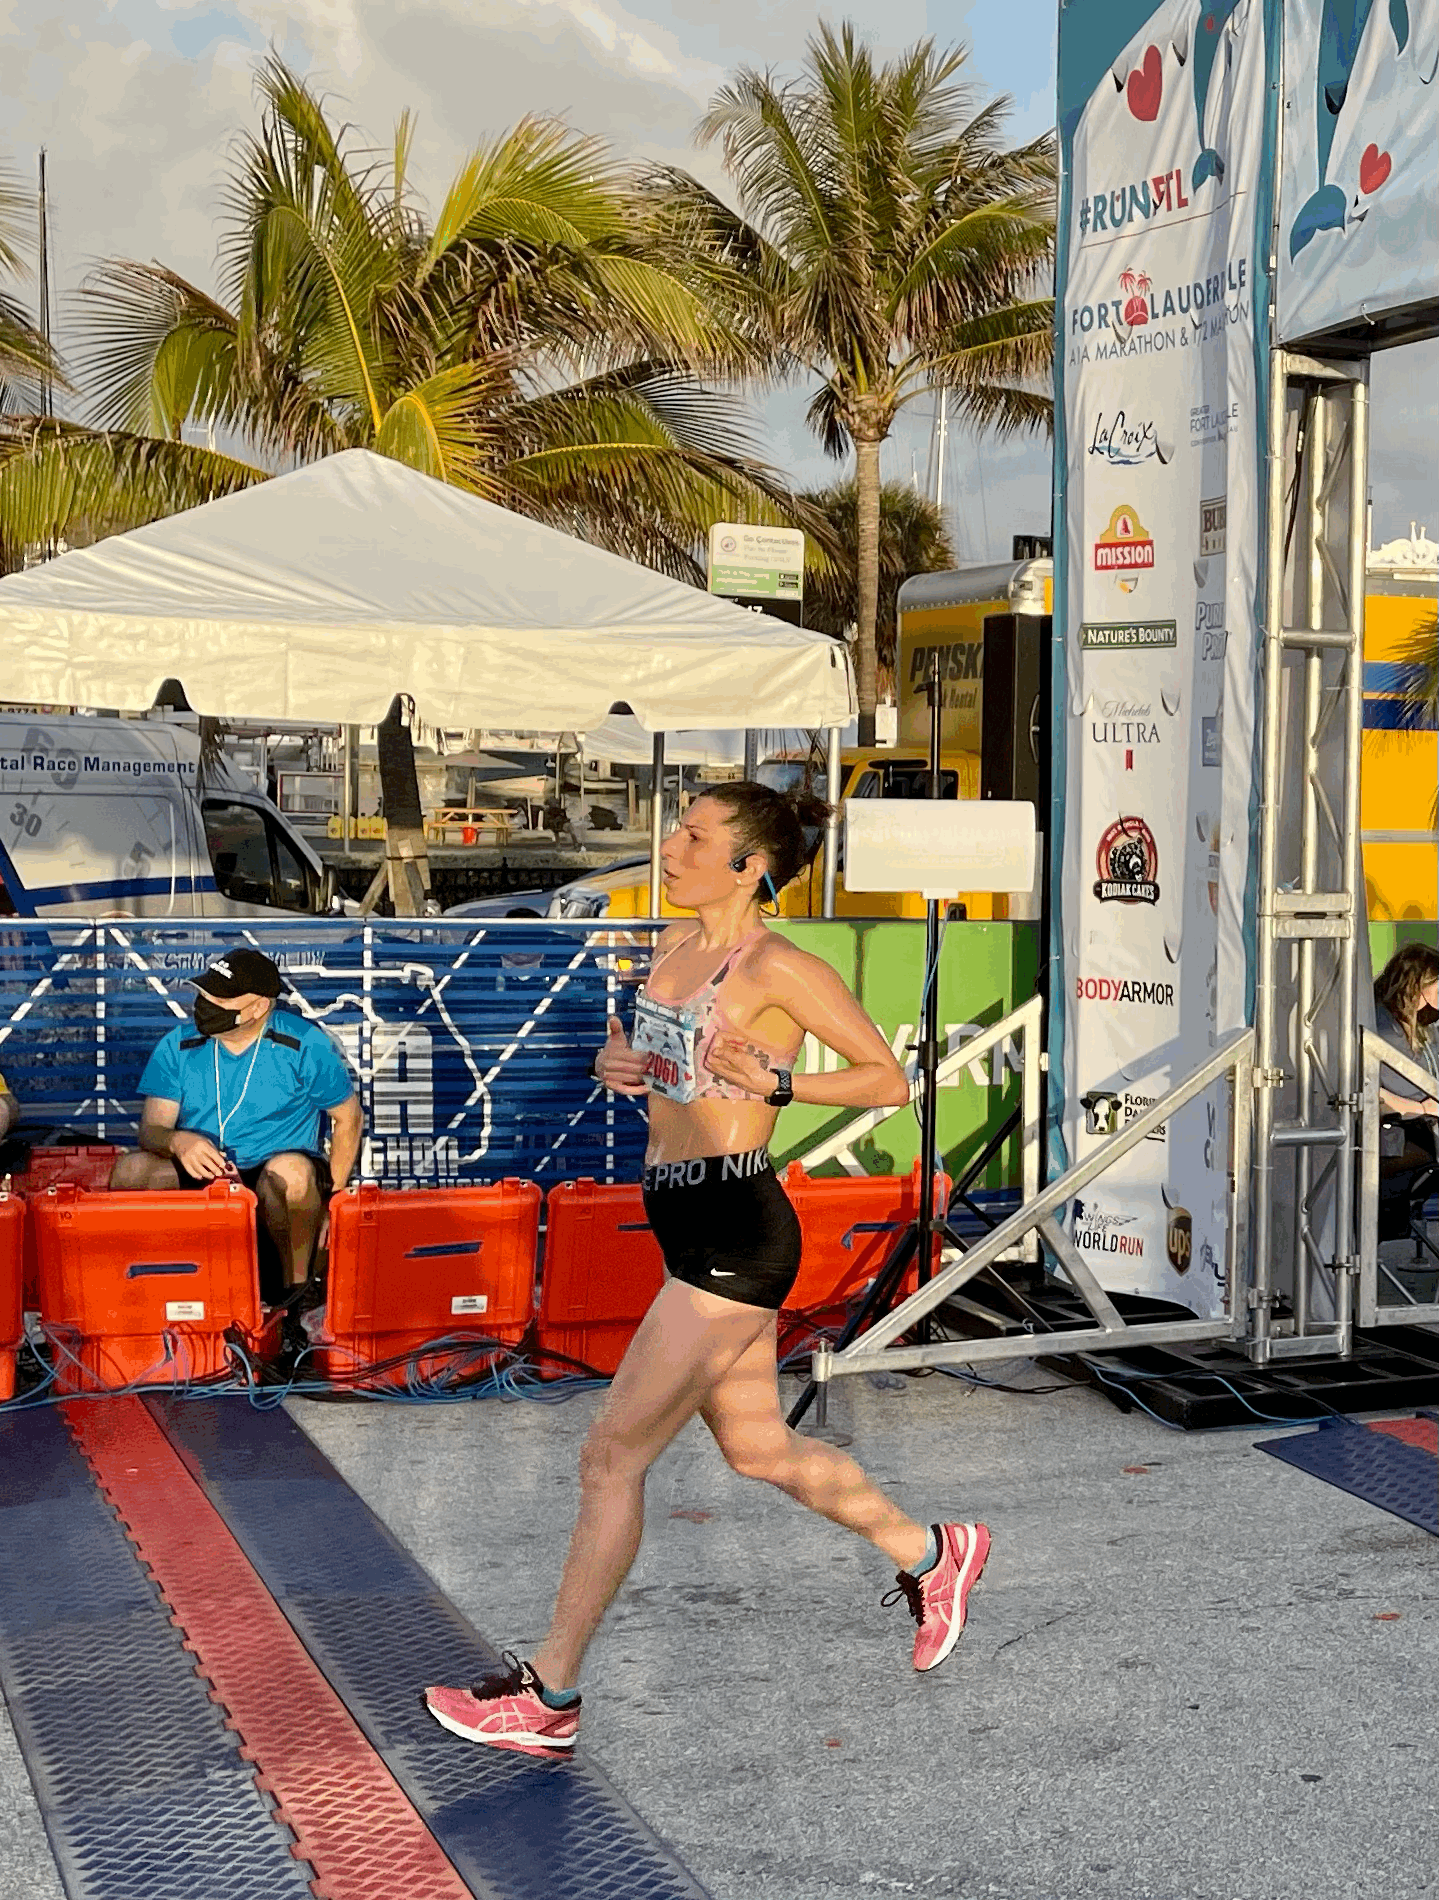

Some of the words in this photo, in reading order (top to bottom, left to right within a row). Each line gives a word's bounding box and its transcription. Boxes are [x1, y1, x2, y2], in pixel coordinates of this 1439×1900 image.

[1072, 300, 1124, 336] FORT
[1095, 328, 1176, 362] MARATHON
[1180, 326, 1188, 347] &
[1092, 722, 1161, 743] ULTRA
[33, 756, 77, 771] Race
[84, 756, 196, 777] Management
[10, 802, 42, 838] 30
[1101, 882, 1132, 899] KODIAK
[1169, 1227, 1191, 1266] ups
